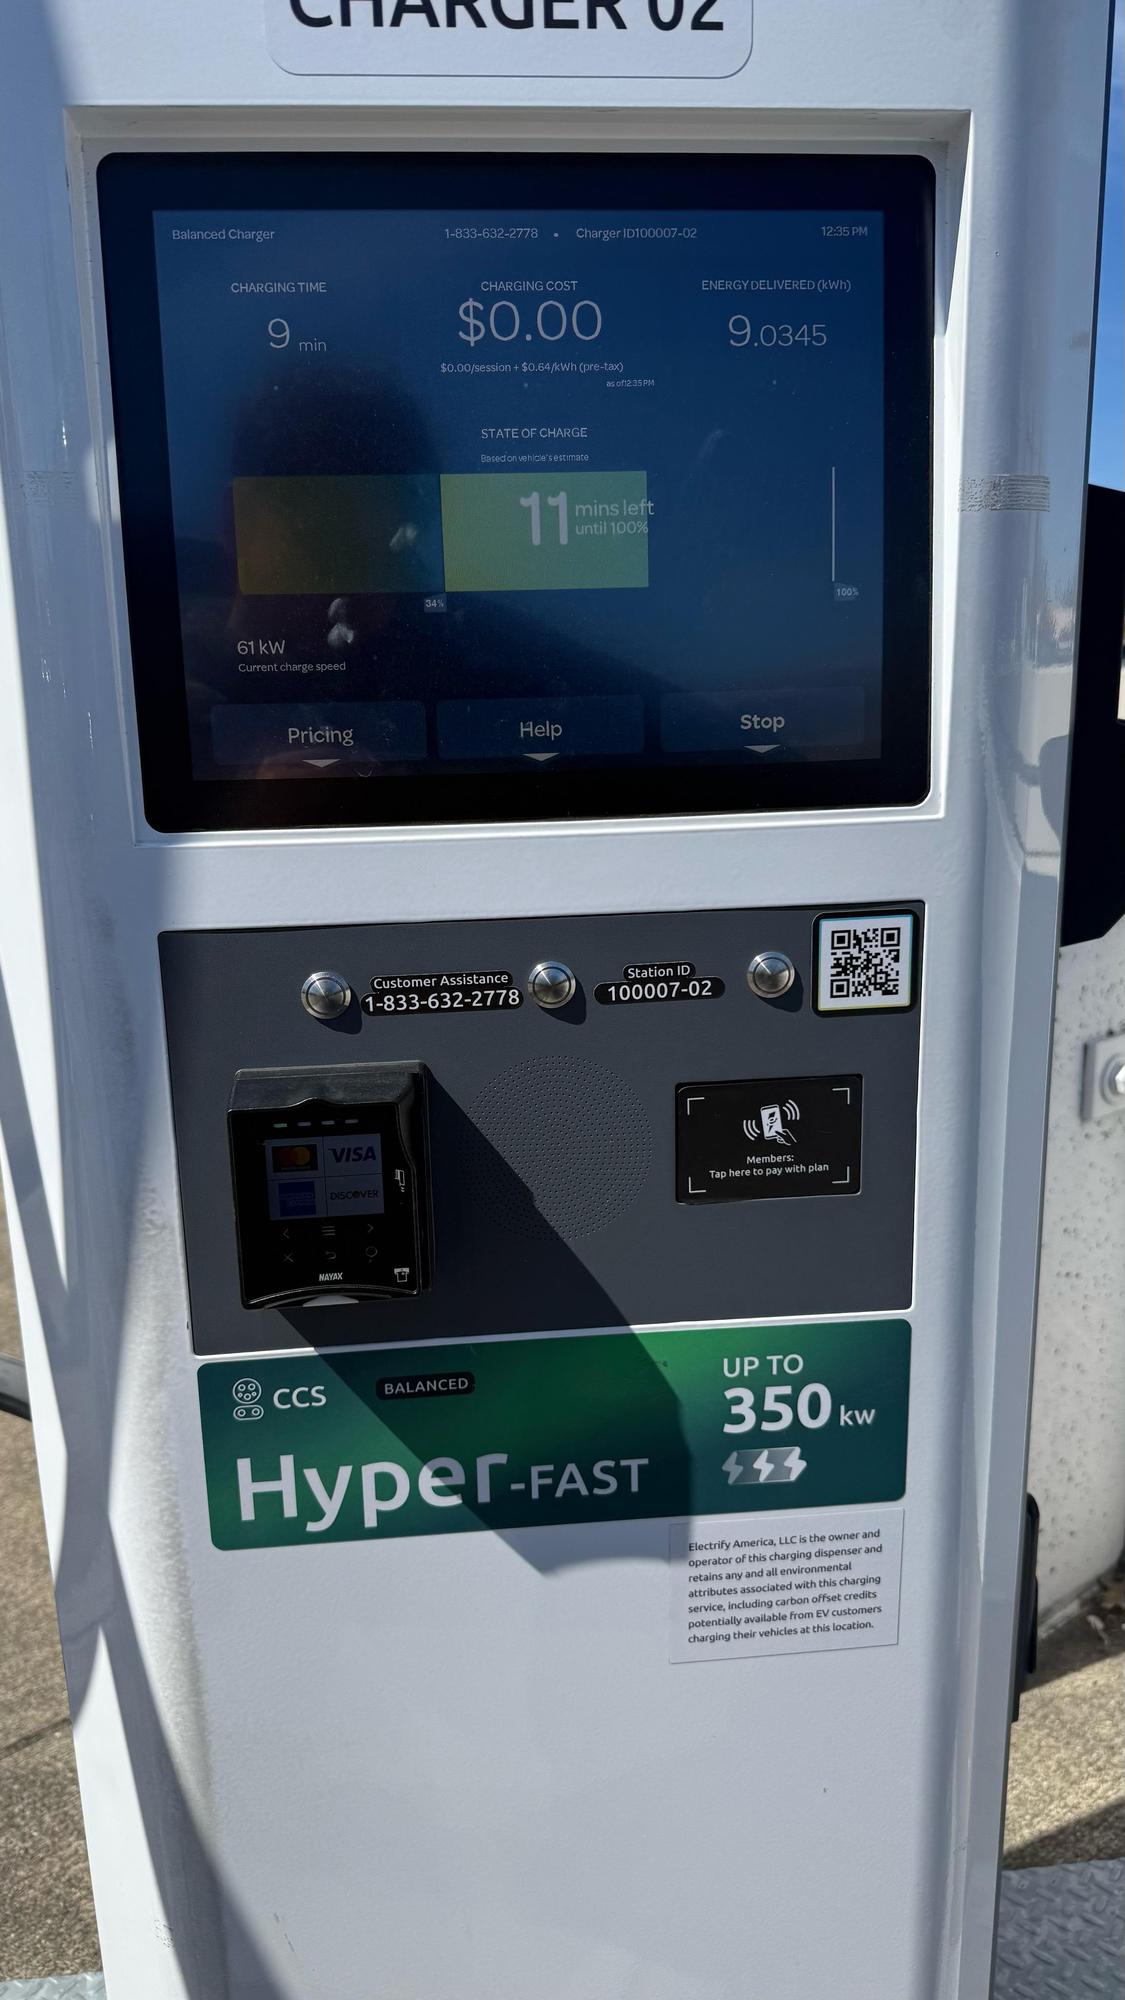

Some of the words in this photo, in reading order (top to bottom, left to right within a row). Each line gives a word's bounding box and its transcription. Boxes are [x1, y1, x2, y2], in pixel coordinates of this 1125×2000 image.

[172, 229, 226, 240] Balanced
[228, 229, 275, 243] Charger
[444, 228, 539, 240] 1-833-632-2778
[575, 227, 621, 241] Charger
[821, 226, 850, 237] 12:35
[852, 226, 868, 236] PM
[230, 282, 295, 294] CHARGING
[297, 282, 327, 293] TIME
[480, 281, 543, 292] CHARGING
[545, 280, 578, 291] COST
[701, 280, 748, 291] ENERGY
[750, 280, 815, 291] DELIVERED
[817, 279, 851, 292] (kWh)
[458, 298, 603, 346] $0.00
[267, 318, 290, 349] 9
[299, 339, 327, 352] min
[440, 363, 511, 374] $0.00/session
[521, 362, 577, 373] $0.64/kWh
[579, 362, 624, 373] (pre-tax)
[481, 428, 519, 439] STATE
[521, 428, 537, 438] OF
[539, 427, 588, 438] CHARGE
[480, 454, 506, 463] Based
[518, 453, 552, 462] vehicle's
[553, 453, 589, 462] estimate
[575, 499, 620, 517] mins
[623, 498, 655, 516] left
[519, 490, 569, 546] 11
[575, 521, 607, 536] until
[611, 520, 649, 535] 100%
[836, 587, 859, 598] 100%
[425, 599, 444, 608] 34%
[237, 640, 255, 655] 61
[259, 639, 286, 655] kW
[238, 663, 278, 673] Current
[279, 662, 314, 674] charge
[315, 661, 346, 673] speed
[519, 720, 563, 741] Help
[739, 713, 785, 733] Stop
[287, 726, 354, 747] Pricing
[627, 965, 675, 979] Station
[676, 964, 691, 976] ID
[373, 977, 438, 990] Customer
[440, 973, 509, 987] Assistance
[608, 980, 712, 1001] 100007-02
[364, 988, 520, 1013] 1-833-632-2778
[328, 1146, 377, 1163] VISA
[746, 1153, 794, 1165] Members:
[709, 1169, 727, 1180] Tap
[728, 1166, 750, 1177] here
[752, 1166, 764, 1176] to
[765, 1167, 783, 1177] pay
[784, 1163, 806, 1174] with
[808, 1162, 829, 1174] plan
[330, 1189, 378, 1200] DISCOVER
[318, 1272, 343, 1282] NAYAX
[723, 1356, 760, 1378] UP
[766, 1353, 804, 1375] TO
[384, 1377, 469, 1395] BALANCED
[273, 1385, 327, 1409] CCS
[723, 1382, 832, 1434] 350
[689, 1540, 730, 1551] Electrify
[733, 1538, 776, 1549] America,
[779, 1536, 796, 1544] LLC
[799, 1535, 806, 1543] is
[809, 1534, 826, 1543] the
[829, 1533, 859, 1541] owner
[862, 1529, 880, 1538] and
[689, 1556, 731, 1569] operator
[736, 1555, 746, 1564] of
[749, 1553, 766, 1562] this
[769, 1549, 812, 1562] charging
[815, 1547, 861, 1559] dispenser
[864, 1545, 882, 1553] and
[689, 1572, 723, 1582] retains
[725, 1571, 743, 1581] any
[745, 1569, 763, 1578] and
[766, 1567, 777, 1576] all
[780, 1562, 852, 1576] environmental
[688, 1586, 737, 1597] attributes
[741, 1583, 792, 1593] associated
[795, 1580, 816, 1589] with
[819, 1579, 836, 1588] this
[839, 1575, 881, 1588] charging
[688, 1602, 725, 1613] service,
[728, 1598, 772, 1610] including
[776, 1596, 809, 1606] carbon
[812, 1593, 841, 1603] offset
[844, 1590, 877, 1600] credits
[688, 1617, 741, 1629] potentially
[744, 1612, 787, 1624] available
[790, 1610, 813, 1620] from
[816, 1609, 829, 1618] EV
[832, 1605, 882, 1617] customers
[688, 1631, 730, 1643] charging
[733, 1629, 755, 1639] their
[759, 1626, 798, 1637] vehicles
[813, 1623, 830, 1632] this
[833, 1620, 873, 1631] location.
